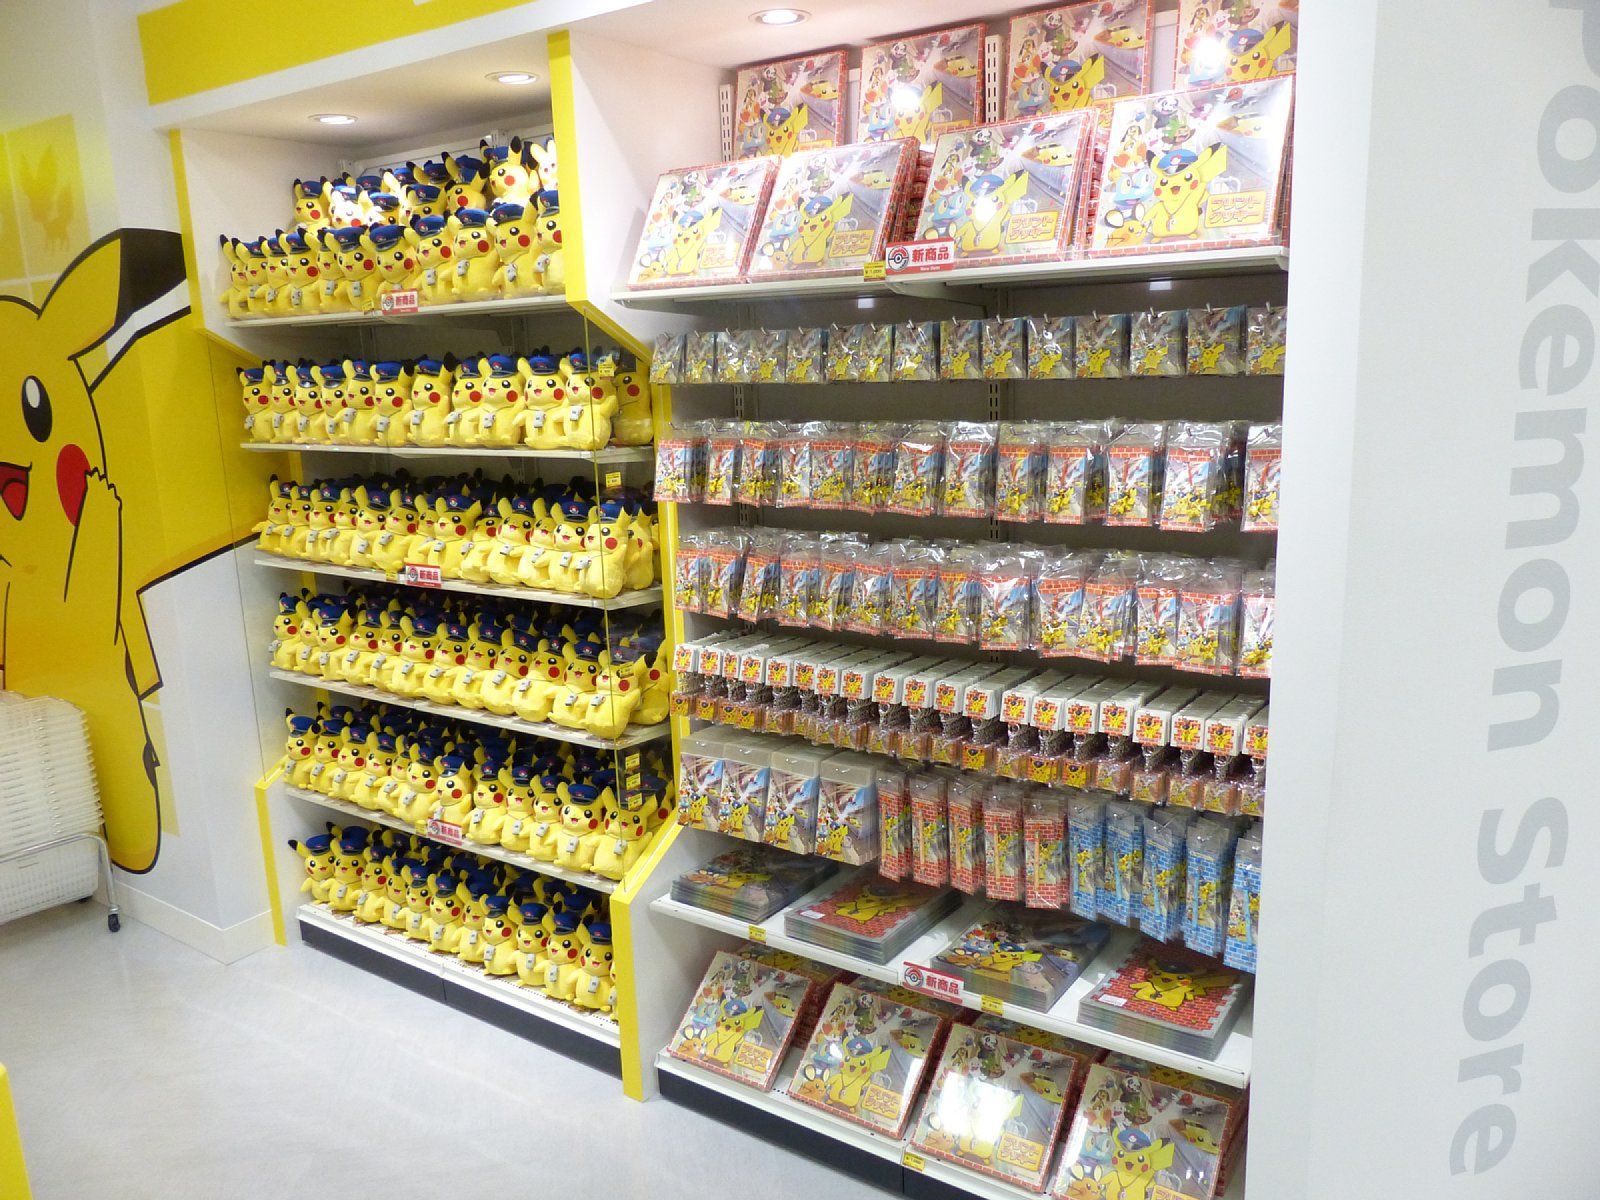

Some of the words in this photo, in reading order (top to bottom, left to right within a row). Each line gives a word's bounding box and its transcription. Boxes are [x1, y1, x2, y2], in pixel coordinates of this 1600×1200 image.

[912, 246, 950, 263] 新商品
[926, 975, 959, 995] 新商品
[1449, 796, 1569, 1177] Store
